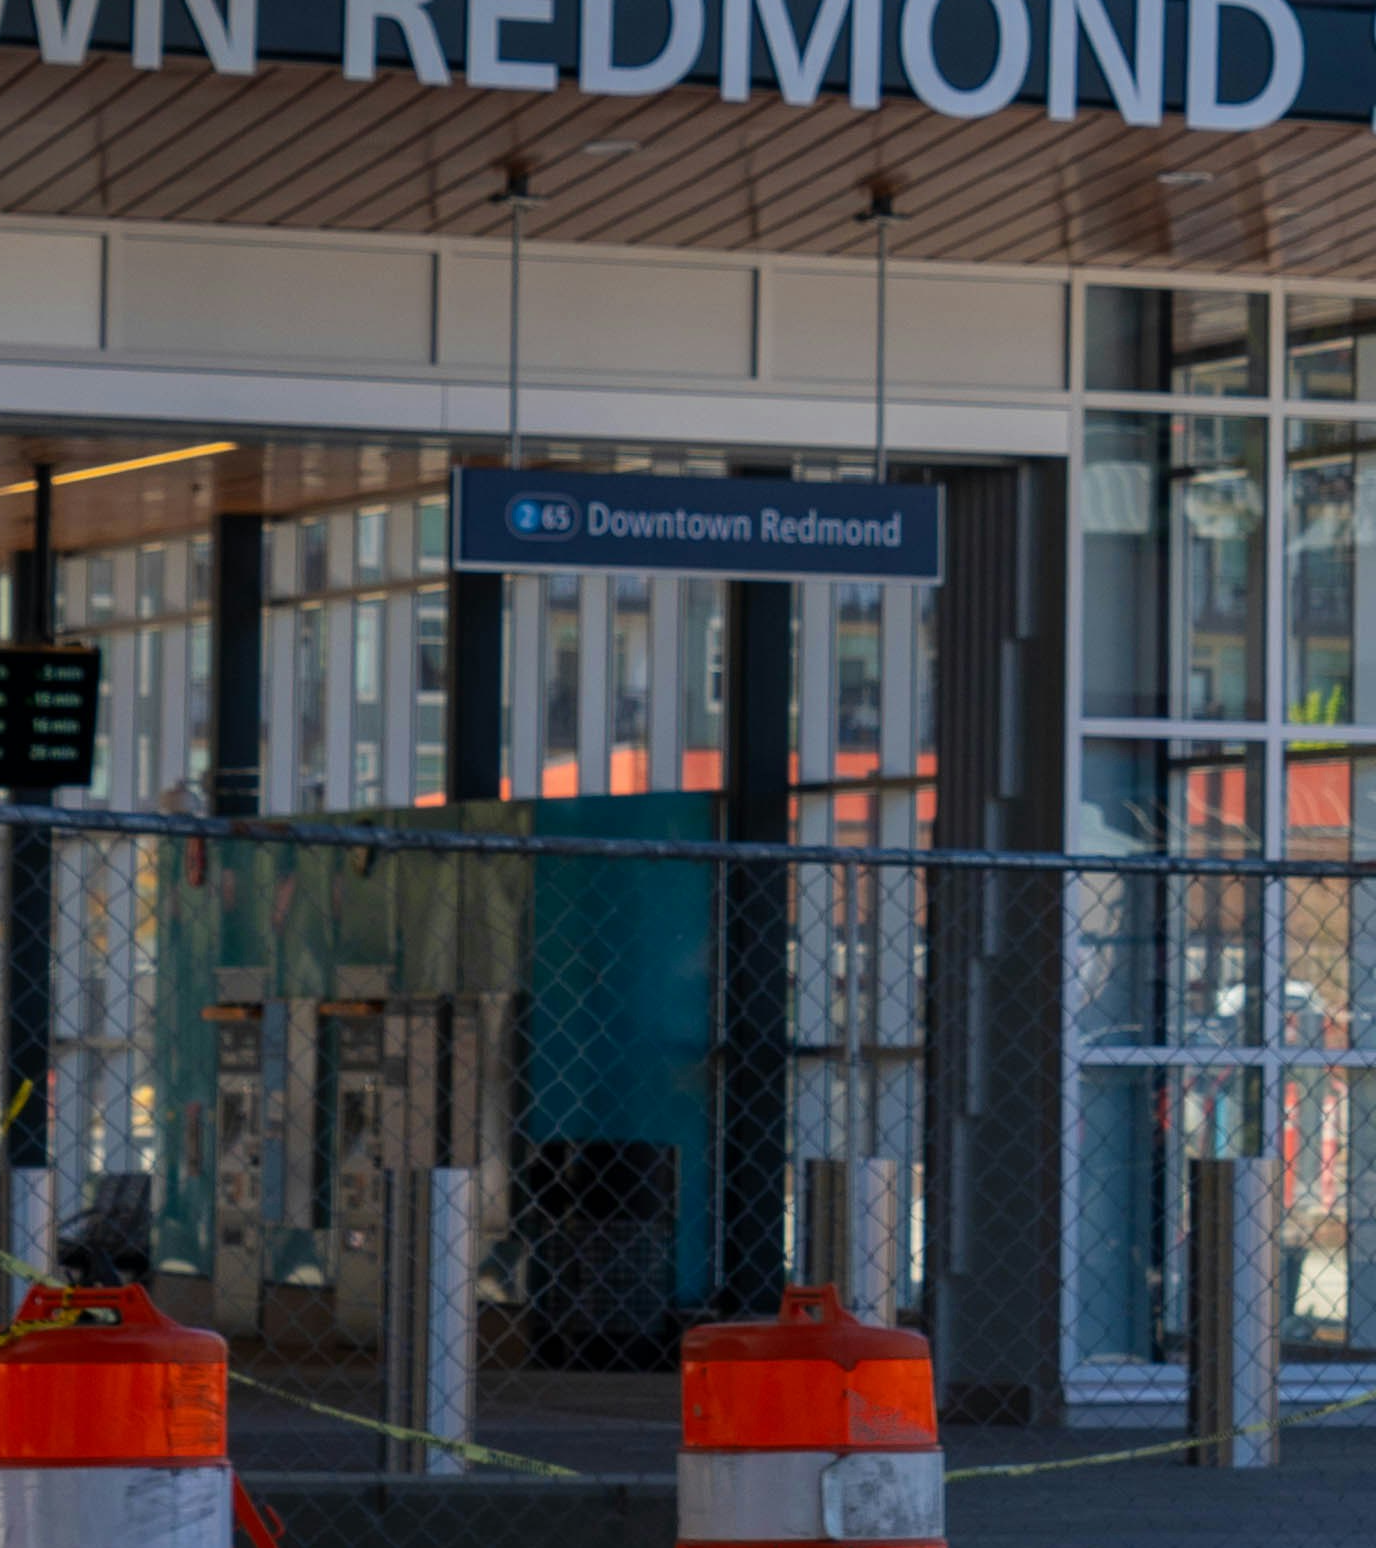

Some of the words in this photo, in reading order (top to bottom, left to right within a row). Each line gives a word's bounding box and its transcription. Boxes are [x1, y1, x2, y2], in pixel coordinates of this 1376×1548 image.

[519, 503, 536, 529] 2
[541, 503, 571, 531] 65
[587, 500, 752, 543] Downtown
[760, 508, 903, 549] Redmond
